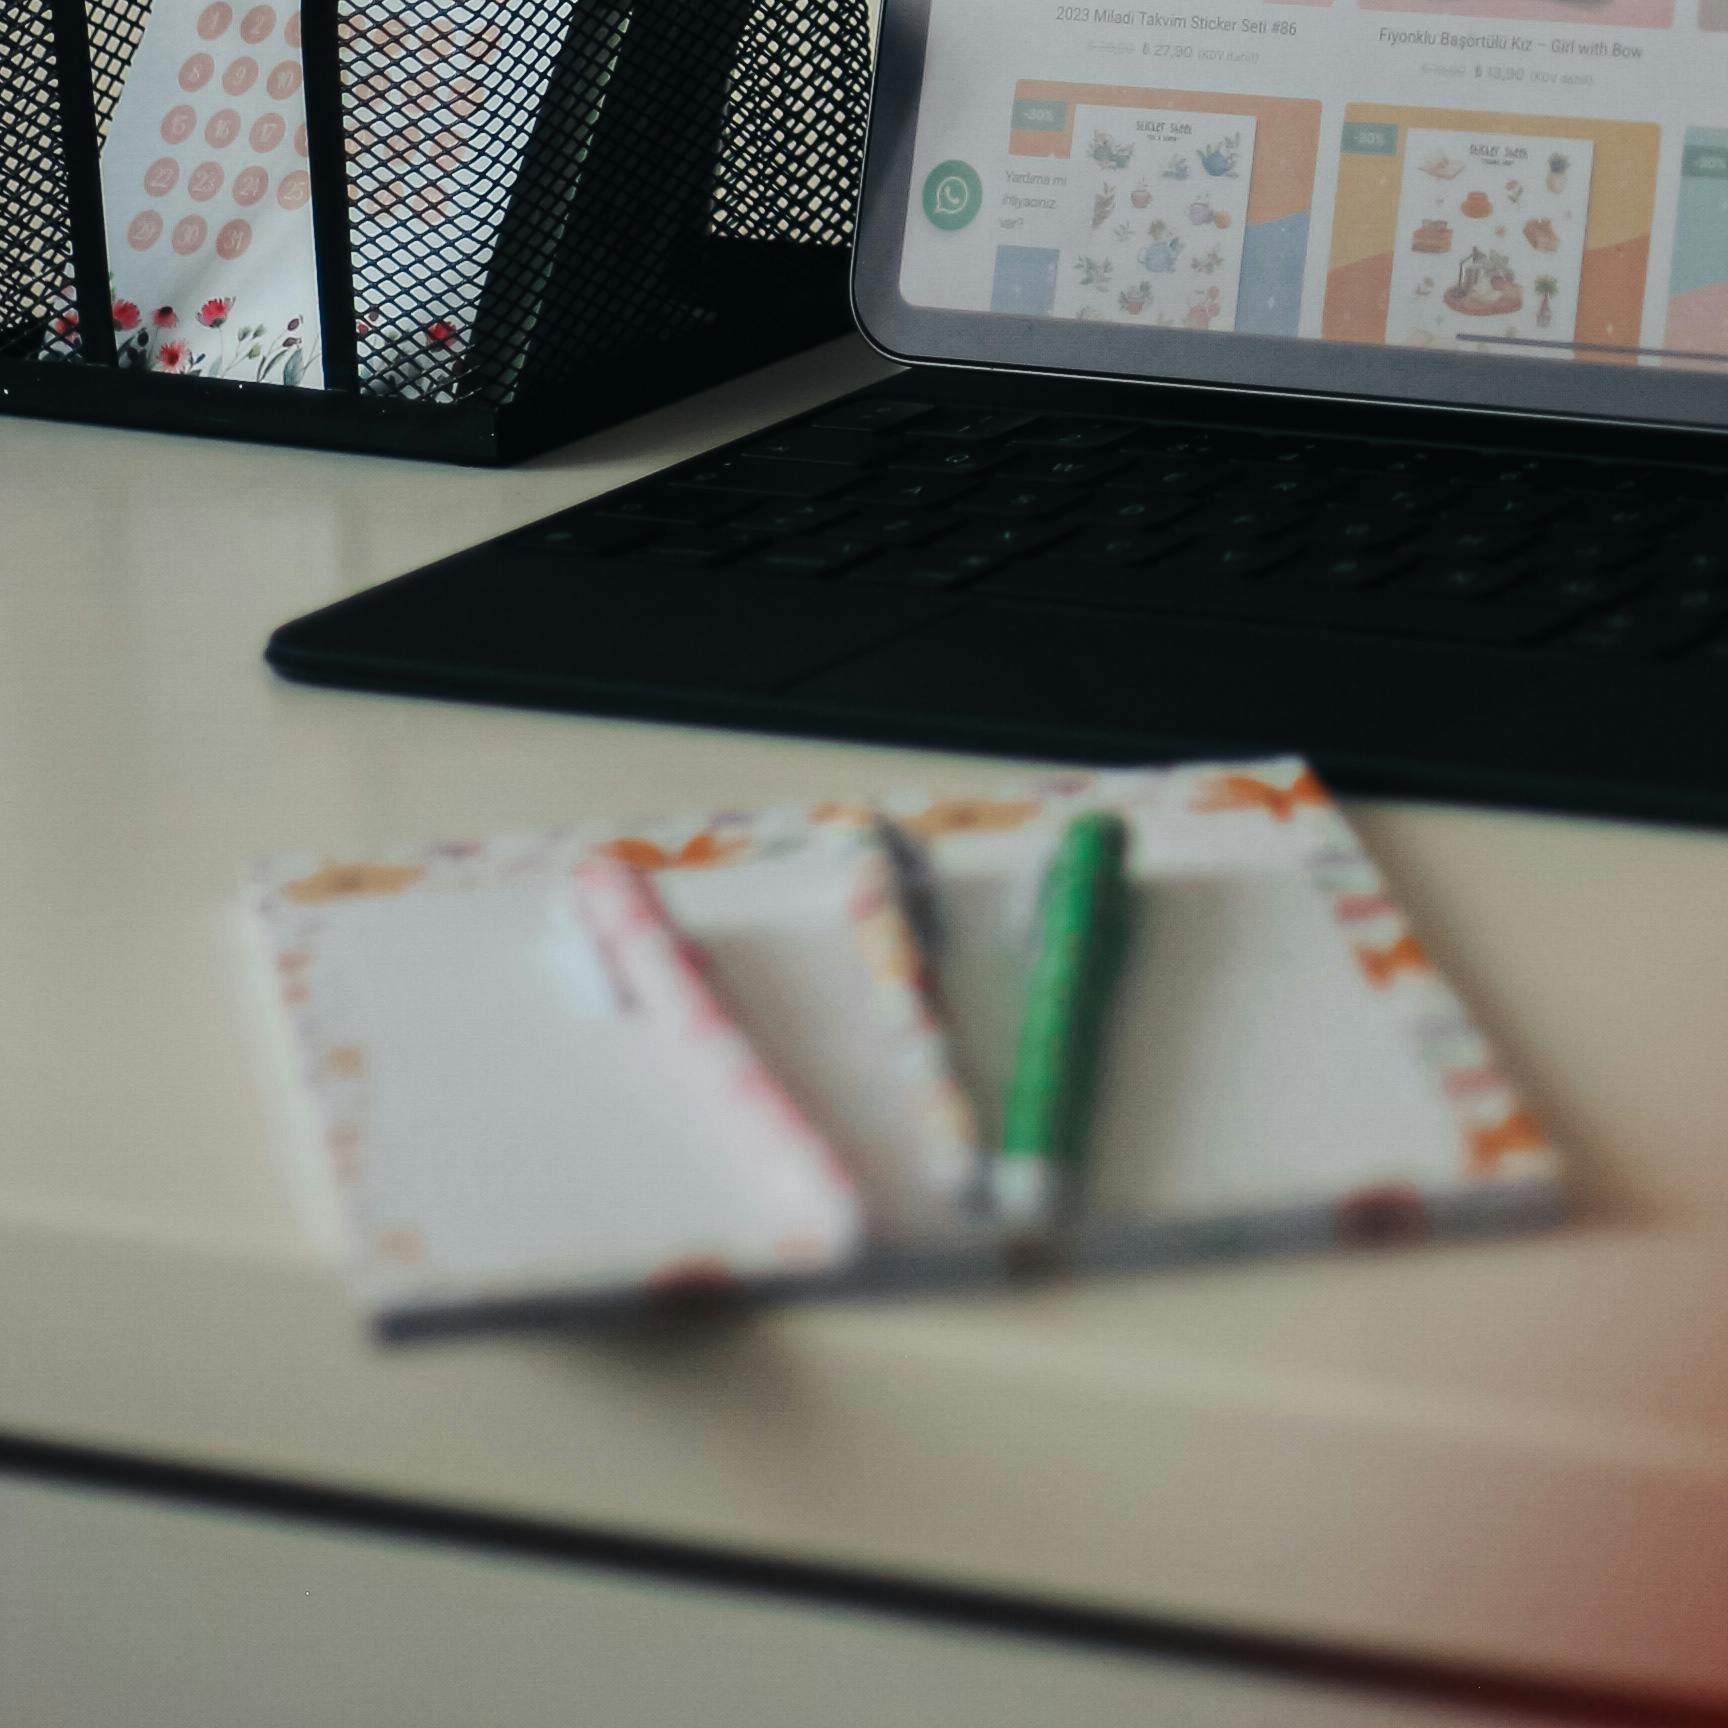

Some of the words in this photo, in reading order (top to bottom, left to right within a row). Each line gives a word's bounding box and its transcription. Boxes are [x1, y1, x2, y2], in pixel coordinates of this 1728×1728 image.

[1056, 5, 1090, 22] 2023
[1094, 8, 1135, 25] Miladi
[1139, 11, 1187, 28] Takvim
[1190, 15, 1237, 32] Sticker
[1241, 18, 1267, 34] Seti
[1271, 20, 1297, 36] #86
[1379, 26, 1435, 47] Fiyonklu
[1551, 38, 1575, 55] Girl
[1578, 41, 1608, 56] with
[1611, 42, 1644, 59] Bow
